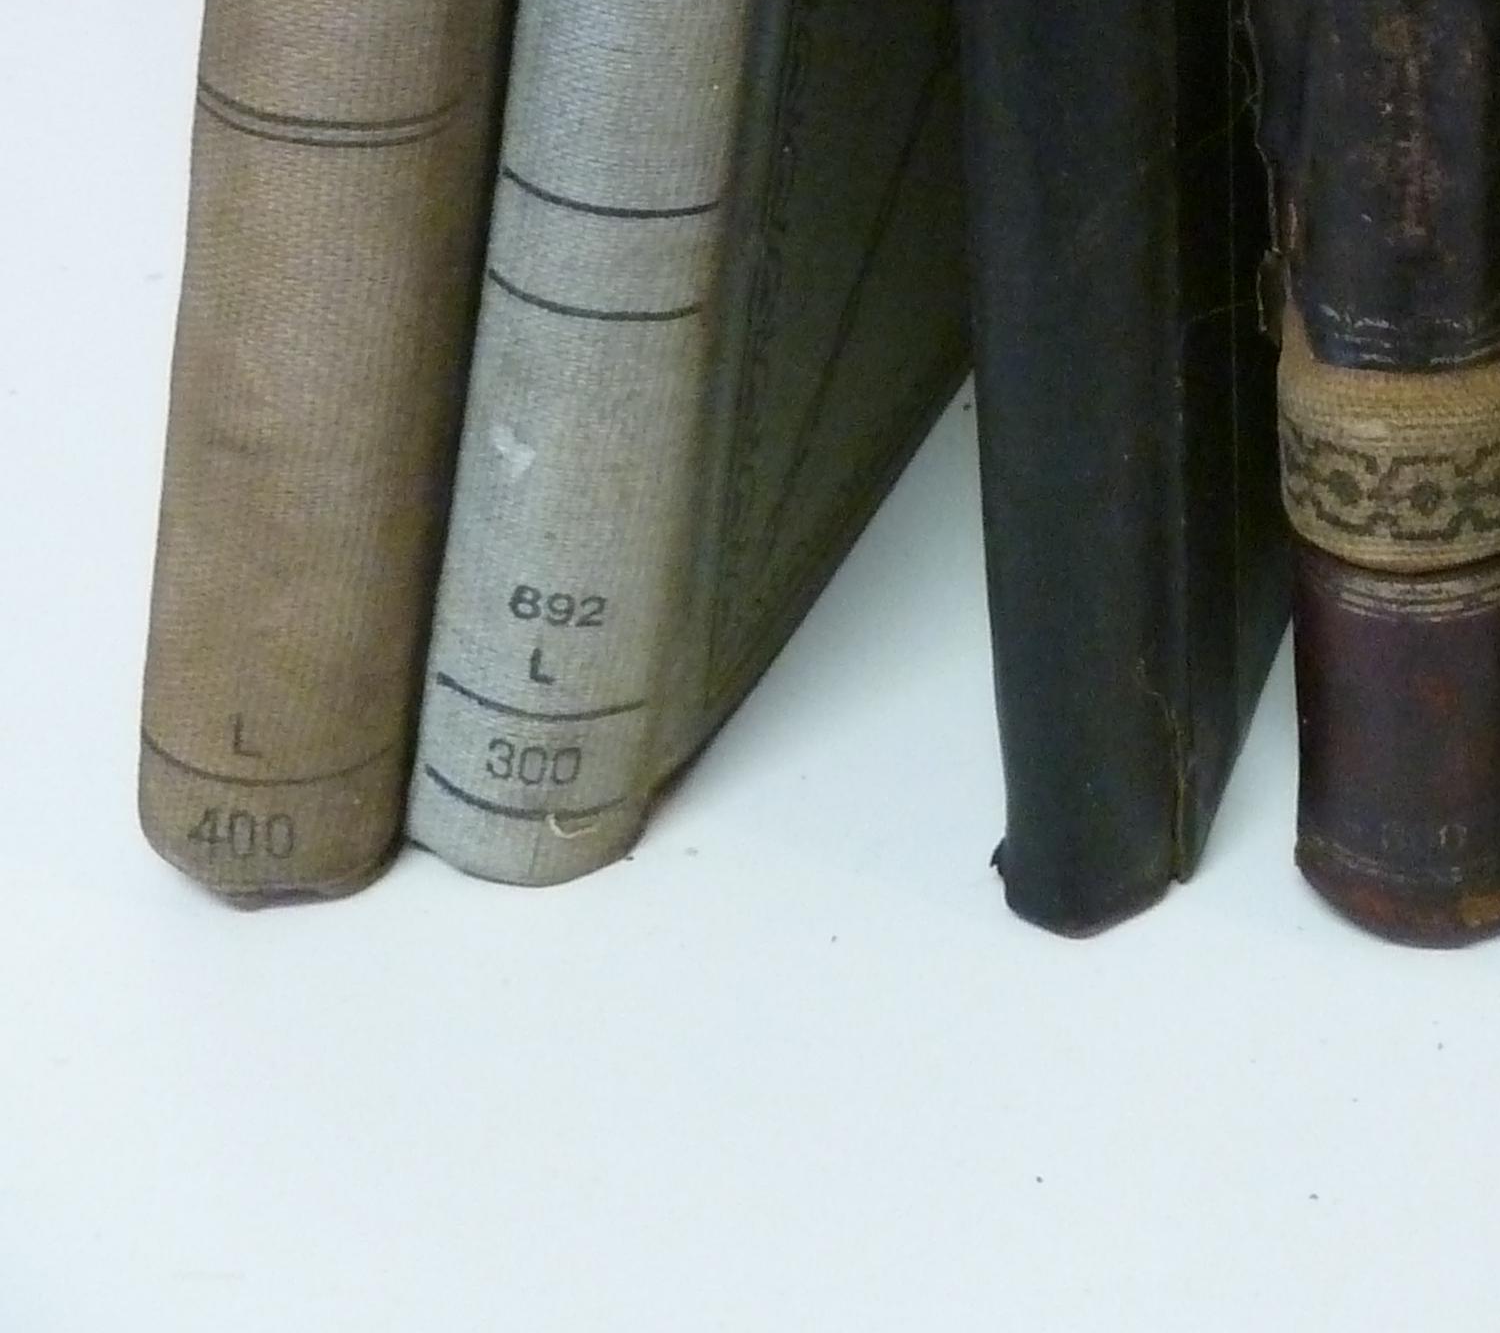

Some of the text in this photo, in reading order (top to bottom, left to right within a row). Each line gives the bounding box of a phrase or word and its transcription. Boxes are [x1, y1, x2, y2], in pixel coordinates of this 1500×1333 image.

[508, 585, 607, 627] 892
[529, 647, 556, 686] L
[232, 712, 263, 758] L
[486, 738, 582, 785] 300
[187, 807, 294, 861] 400
